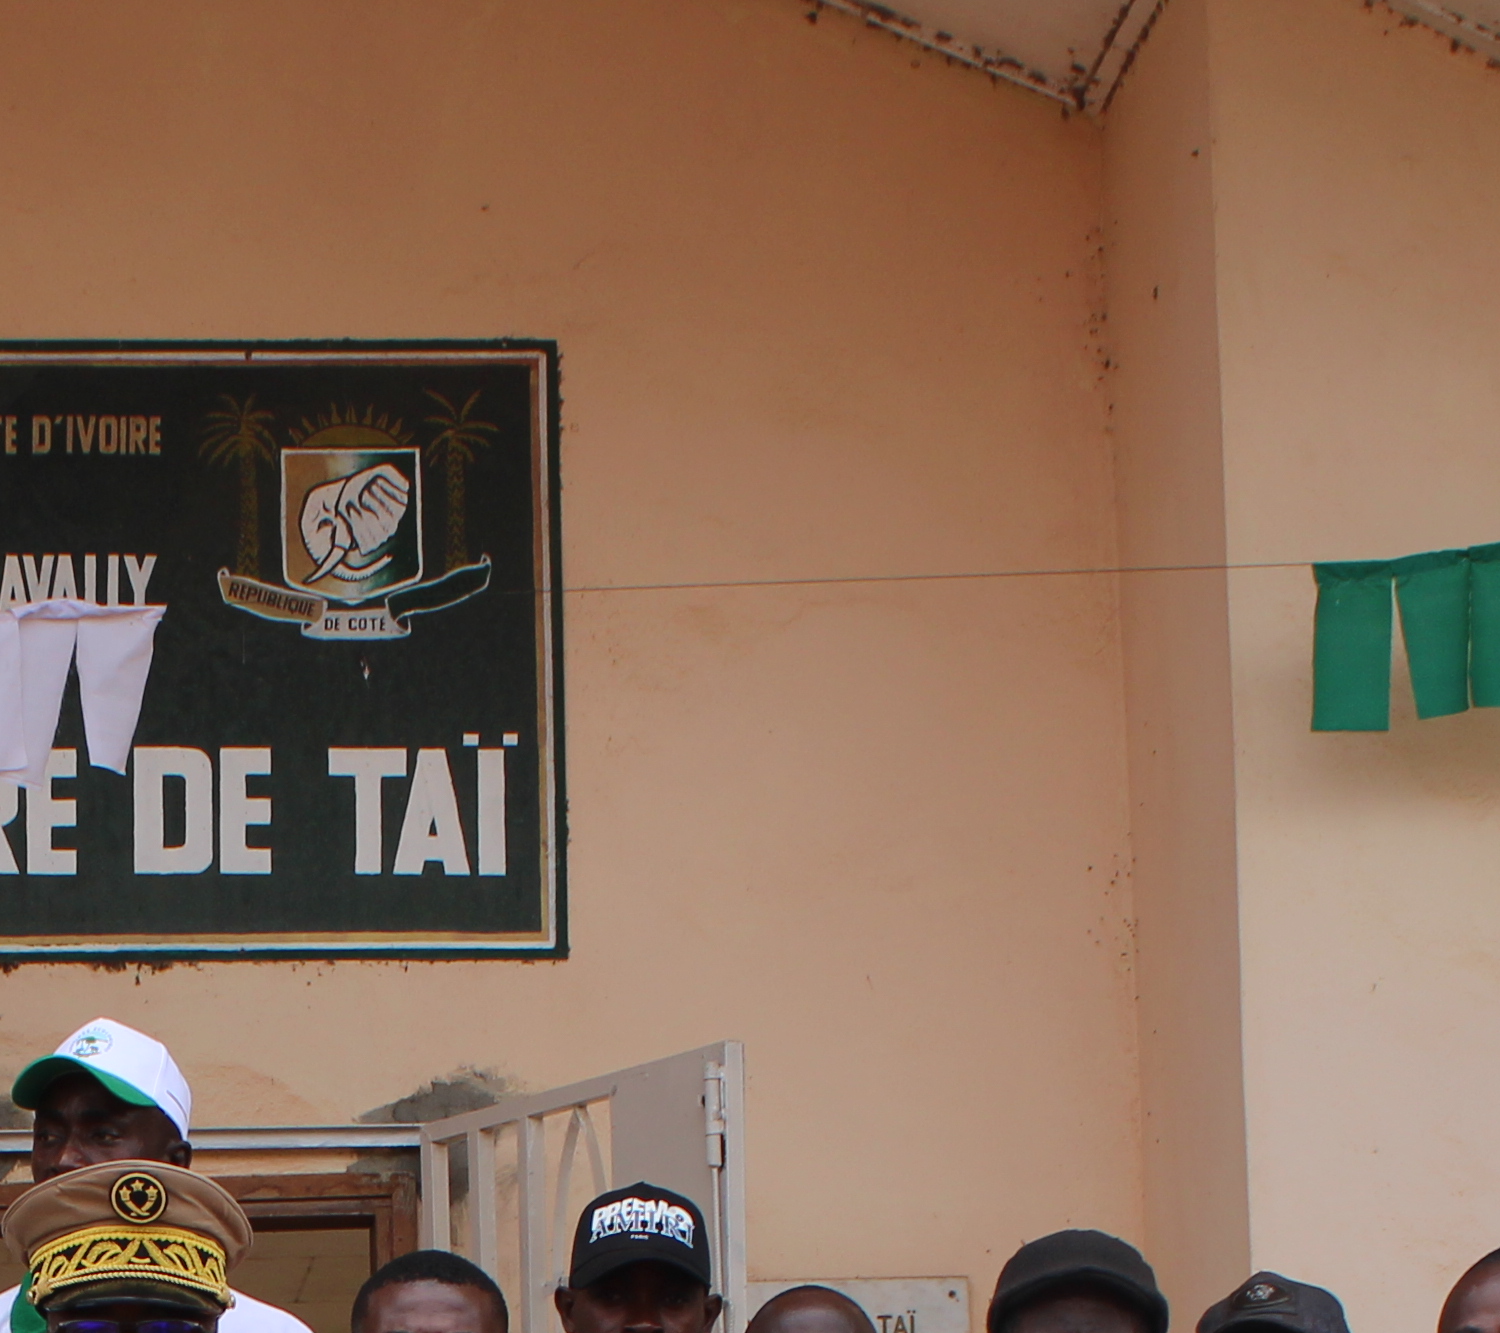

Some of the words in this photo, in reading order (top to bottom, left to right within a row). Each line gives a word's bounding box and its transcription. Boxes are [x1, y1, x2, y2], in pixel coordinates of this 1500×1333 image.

[31, 415, 160, 455] D'IVOIRE
[228, 580, 316, 617] REPUBLIQUE
[324, 617, 341, 632] DE
[132, 747, 271, 876] DE
[328, 732, 519, 876] TAÏ
